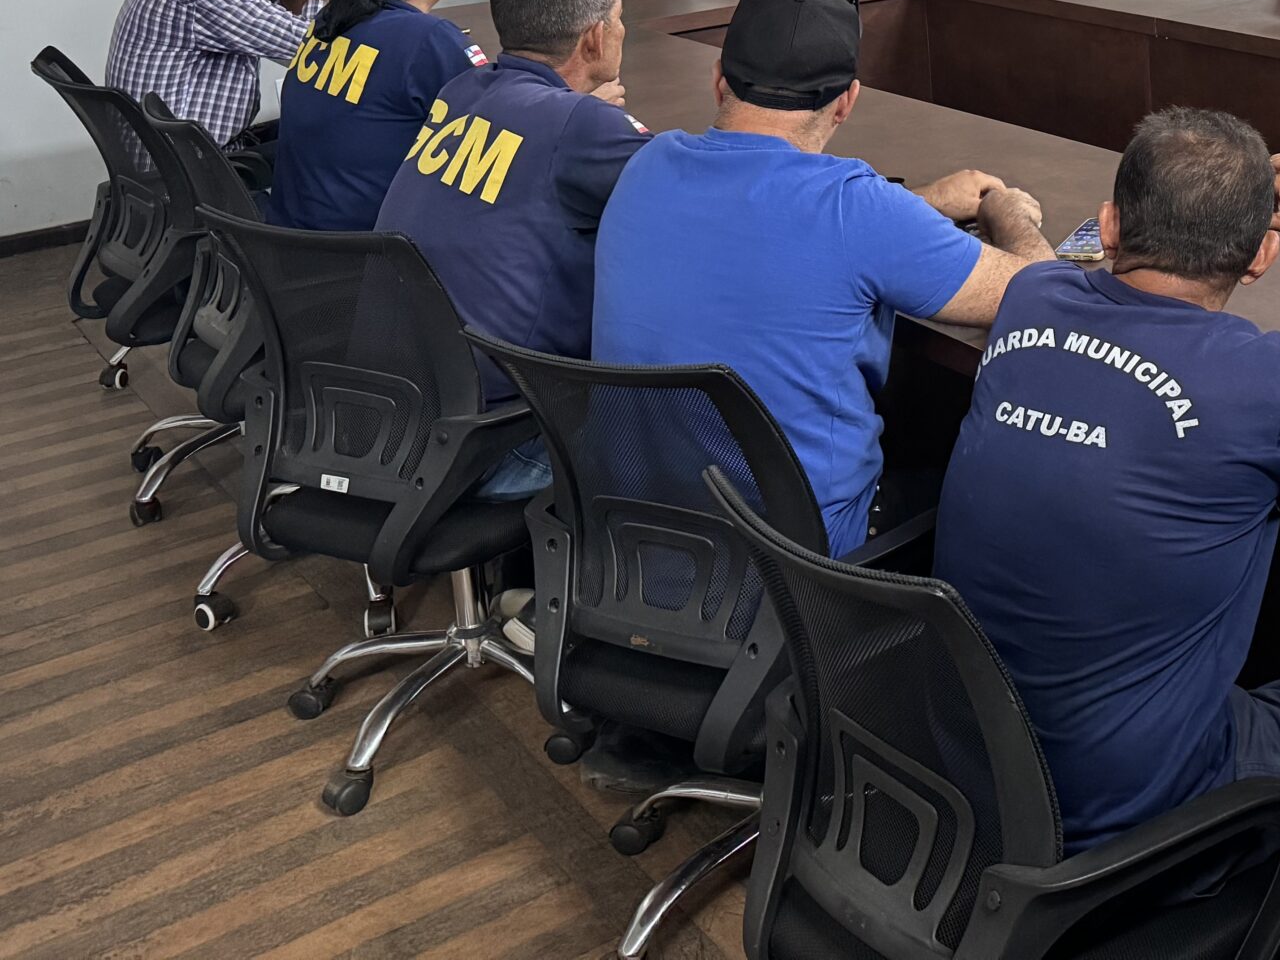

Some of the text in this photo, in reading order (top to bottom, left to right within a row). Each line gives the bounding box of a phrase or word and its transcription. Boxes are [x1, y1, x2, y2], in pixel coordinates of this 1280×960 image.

[975, 328, 1199, 438] UARDA MUNICIPAL
[995, 402, 1107, 448] CATU-BA
